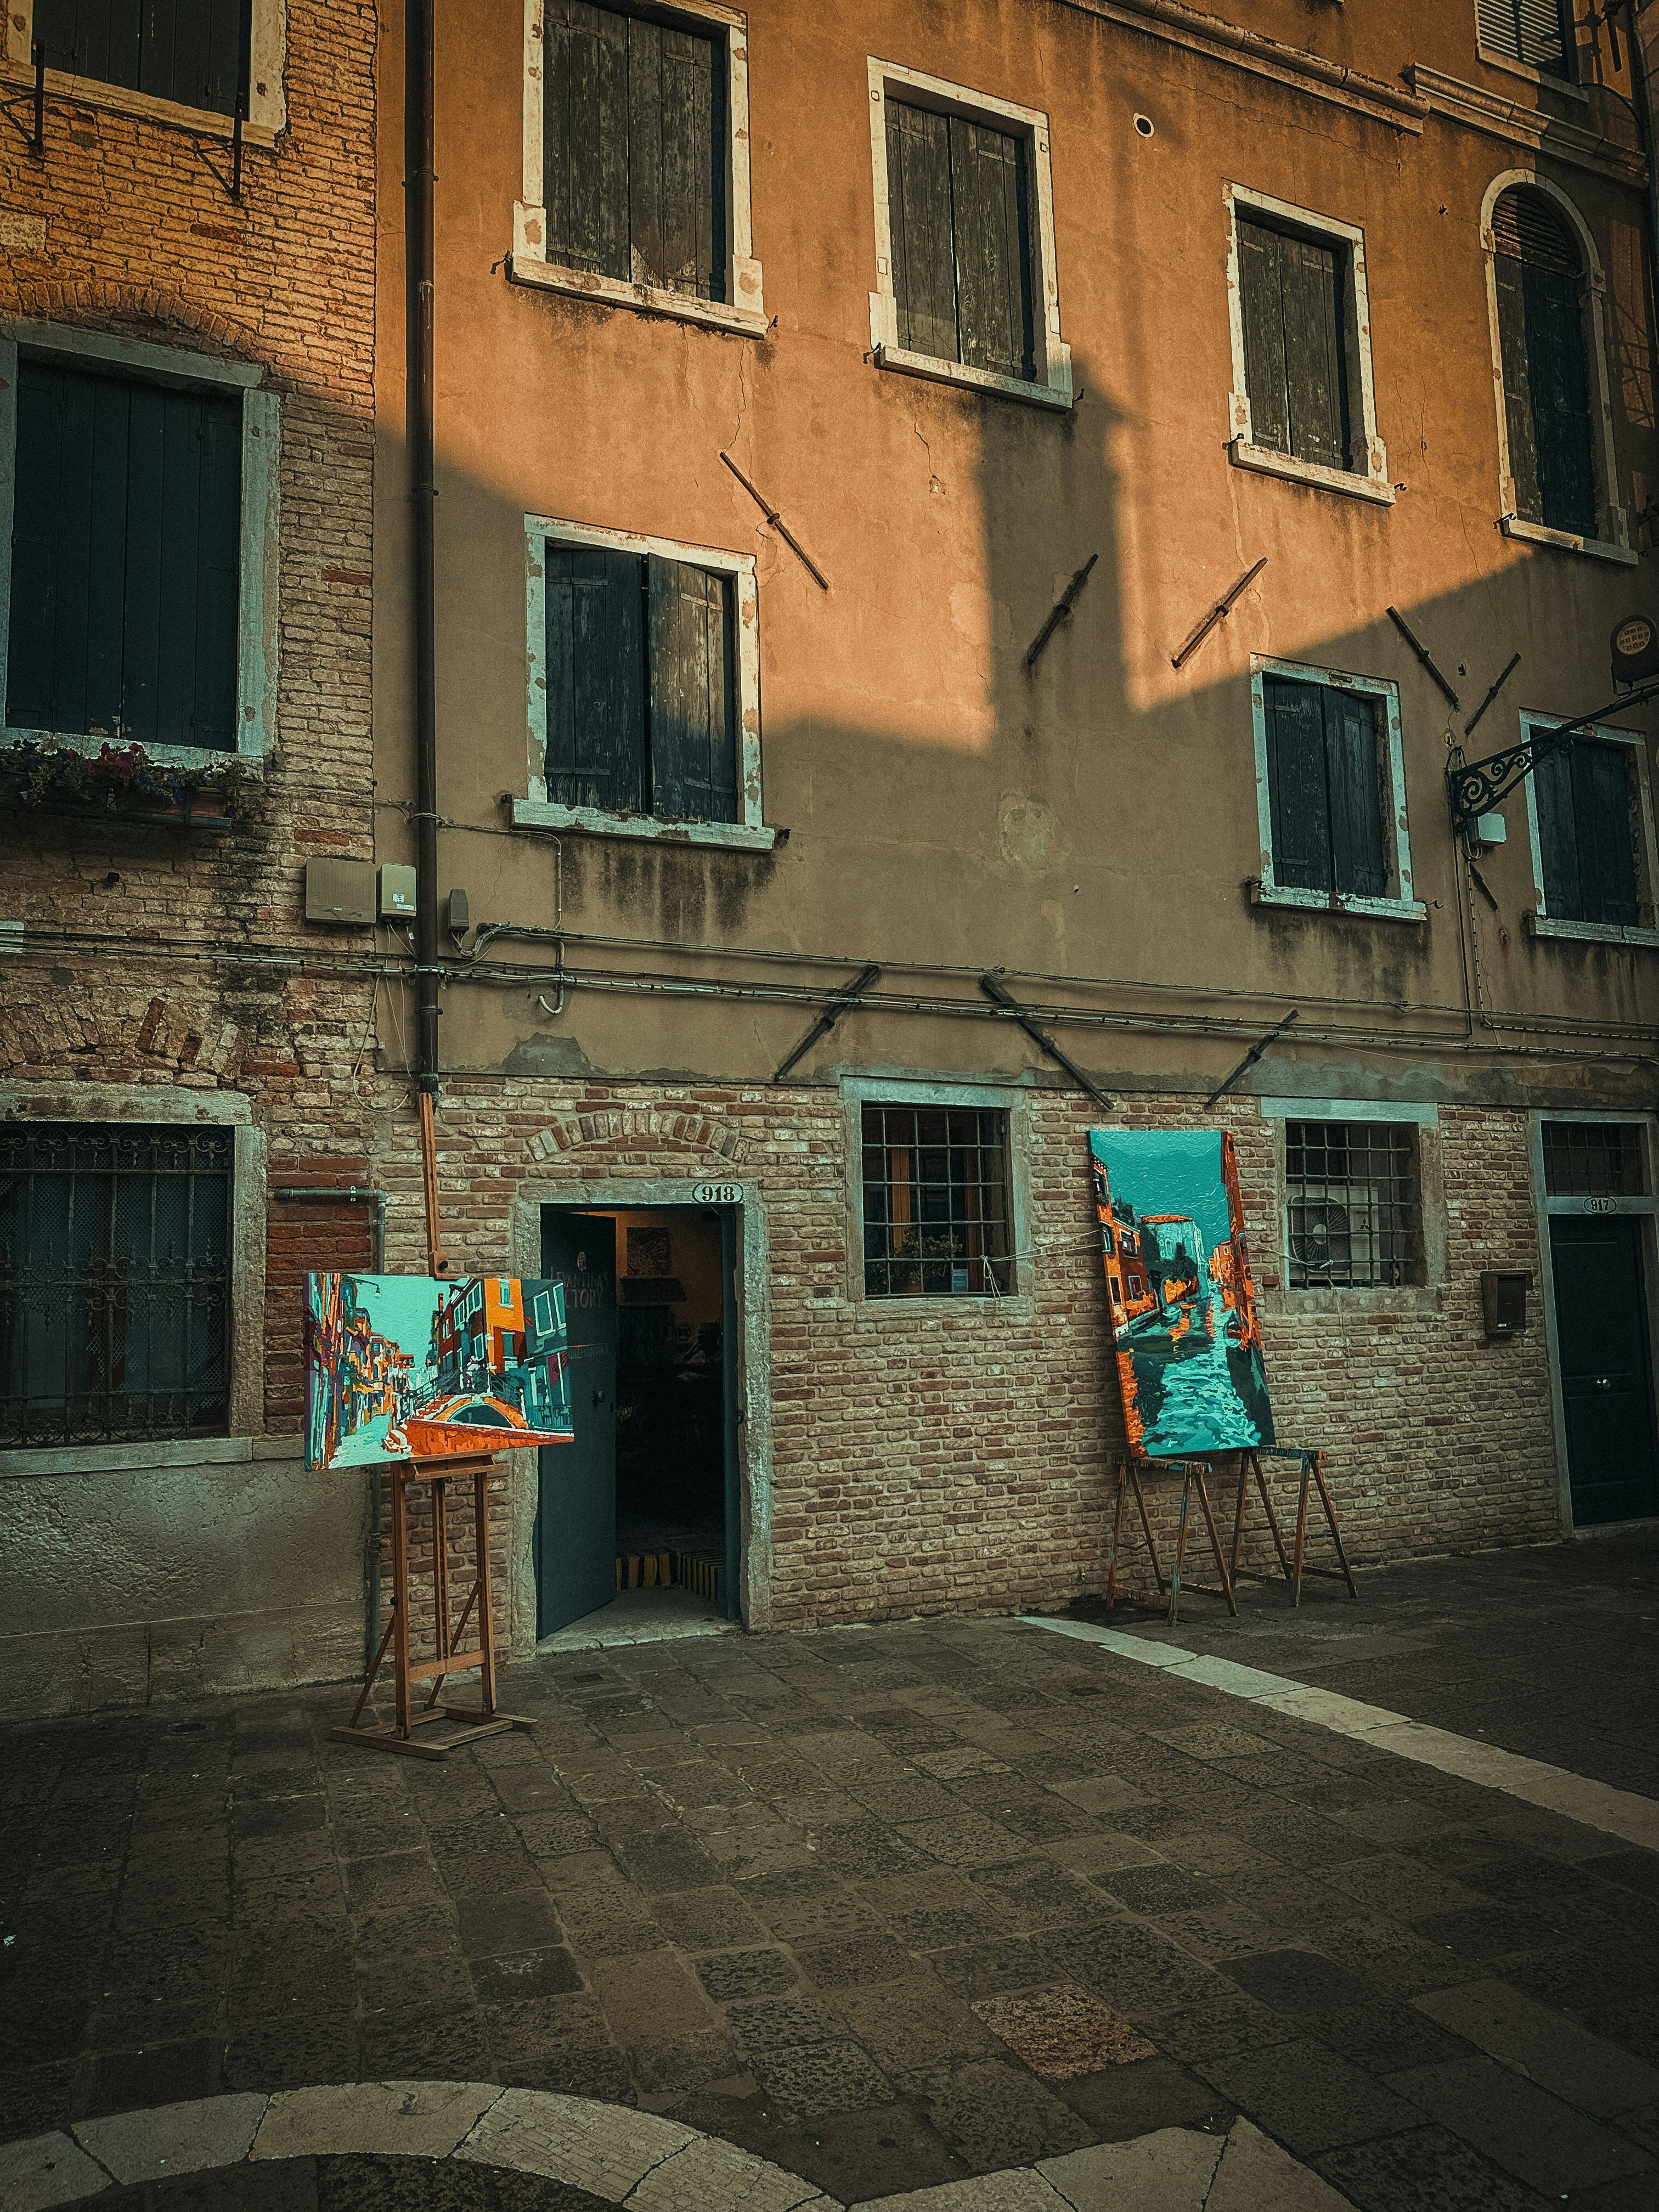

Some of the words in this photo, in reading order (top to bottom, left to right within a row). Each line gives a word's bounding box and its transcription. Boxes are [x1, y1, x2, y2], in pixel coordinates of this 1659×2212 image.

[702, 1186, 735, 1201] 918
[1590, 1199, 1609, 1211] 917
[565, 1288, 603, 1308] CTORY
